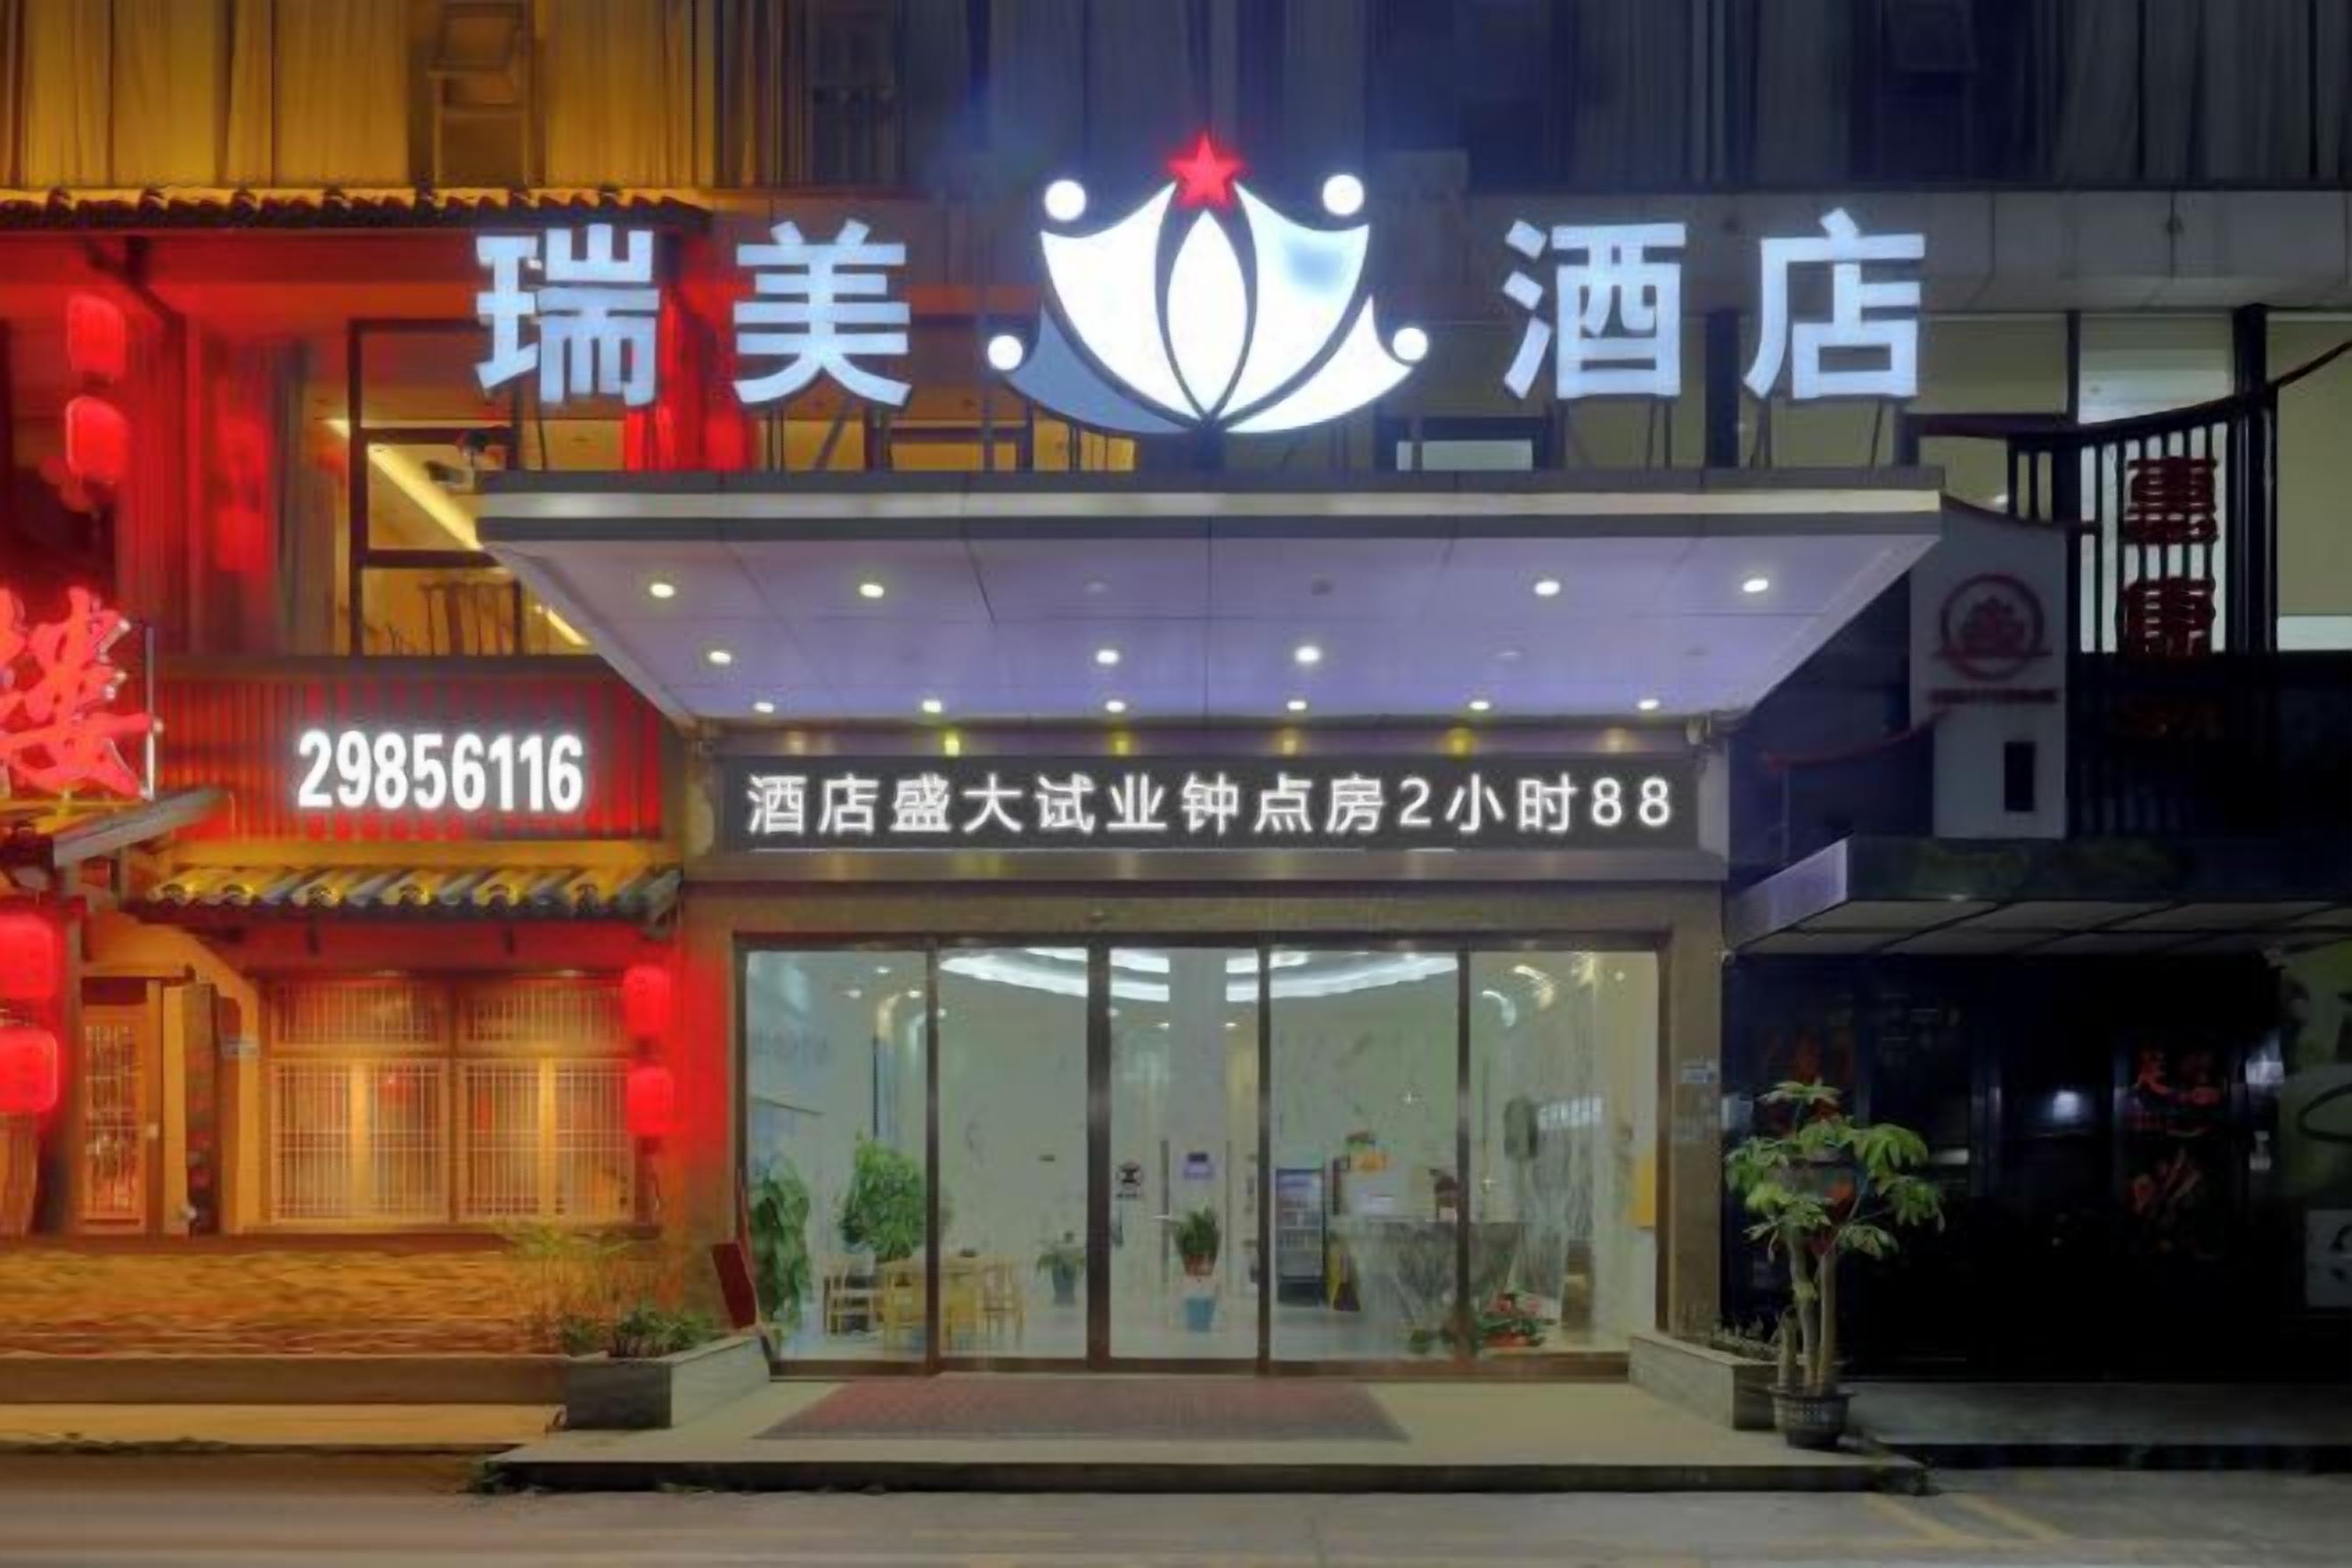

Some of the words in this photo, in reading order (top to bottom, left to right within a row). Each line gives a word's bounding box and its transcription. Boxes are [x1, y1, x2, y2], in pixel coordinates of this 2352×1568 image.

[475, 219, 911, 407] 瑞美
[1503, 208, 1926, 400] 酒店
[297, 727, 584, 813] 29856116
[746, 772, 1672, 836] 酒店盛大试业钟点房2小时88
